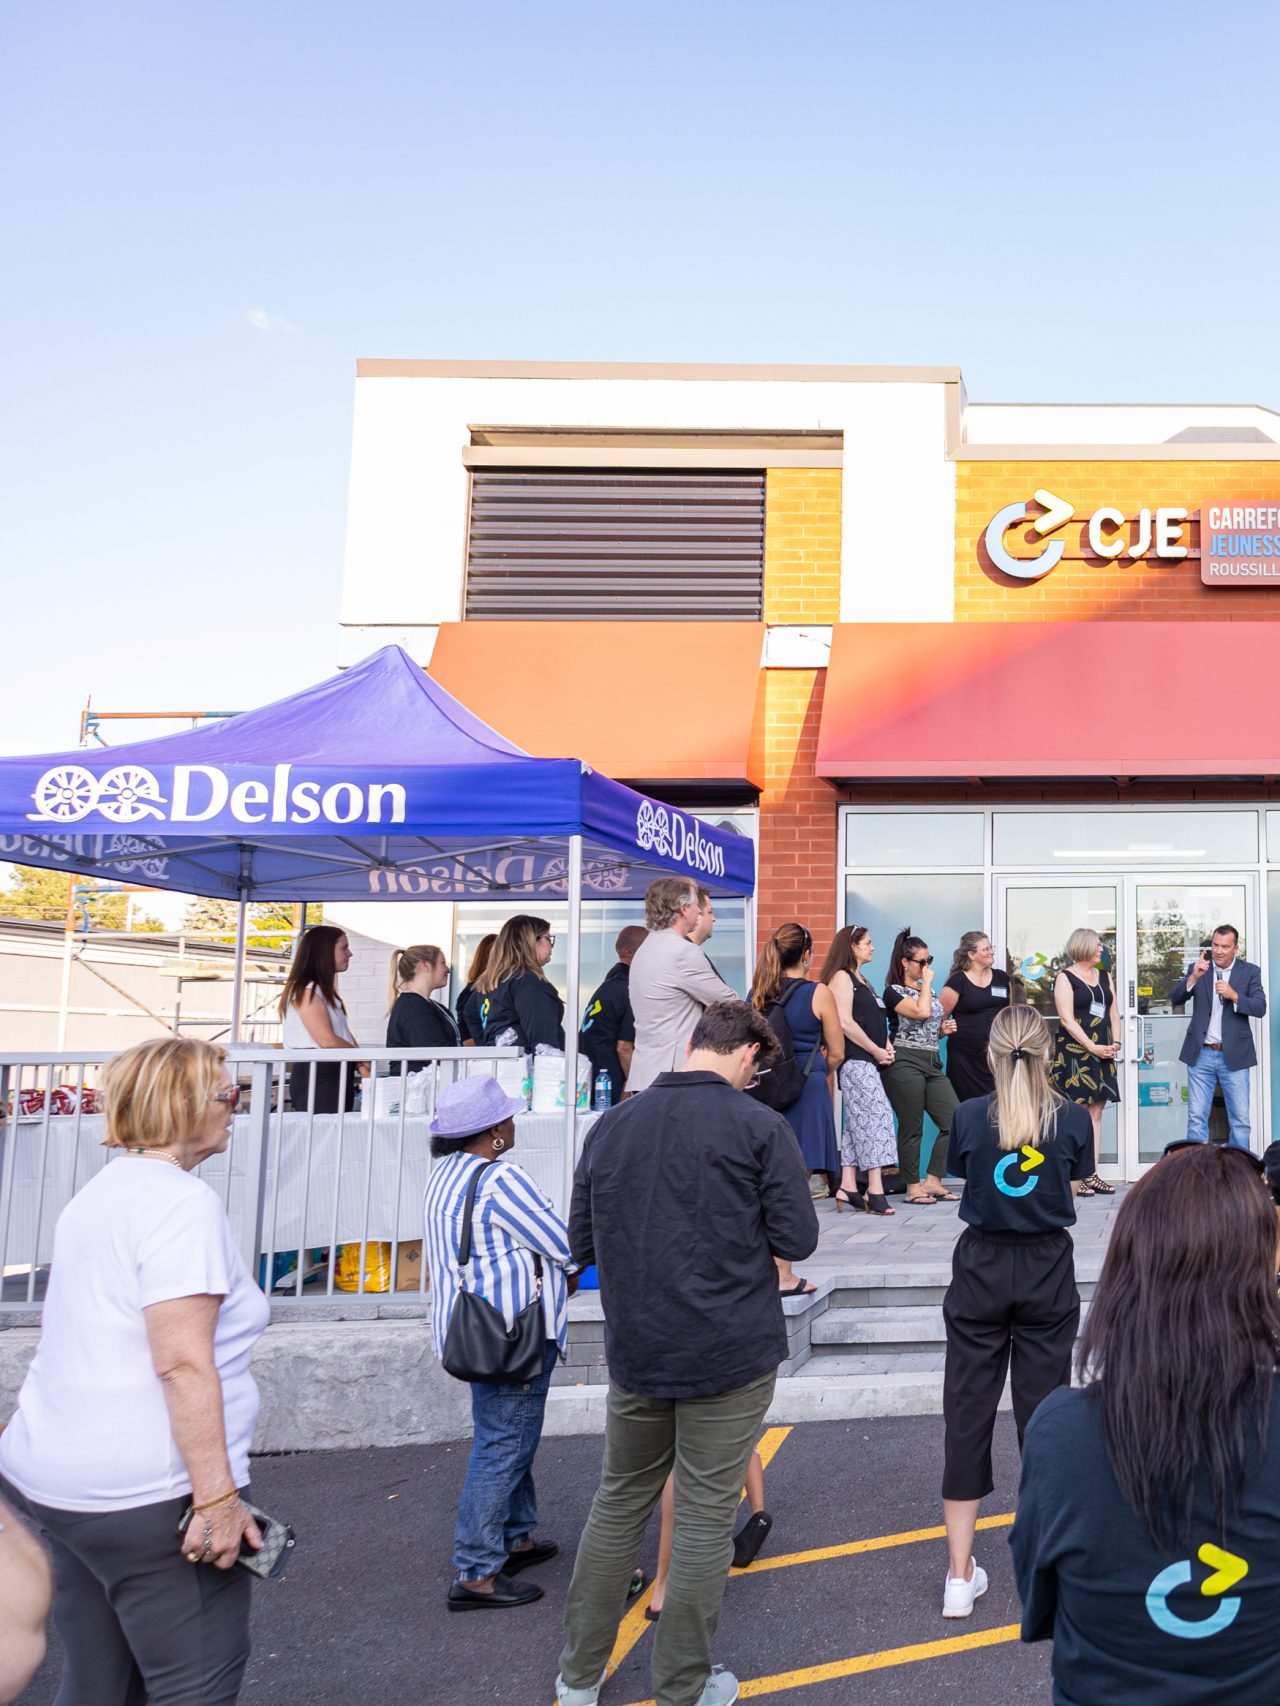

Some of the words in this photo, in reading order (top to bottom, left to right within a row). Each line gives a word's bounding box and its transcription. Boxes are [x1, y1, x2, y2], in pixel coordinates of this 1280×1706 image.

[1089, 507, 1190, 558] CJE
[170, 763, 407, 824] Delson
[671, 812, 725, 878] Delson
